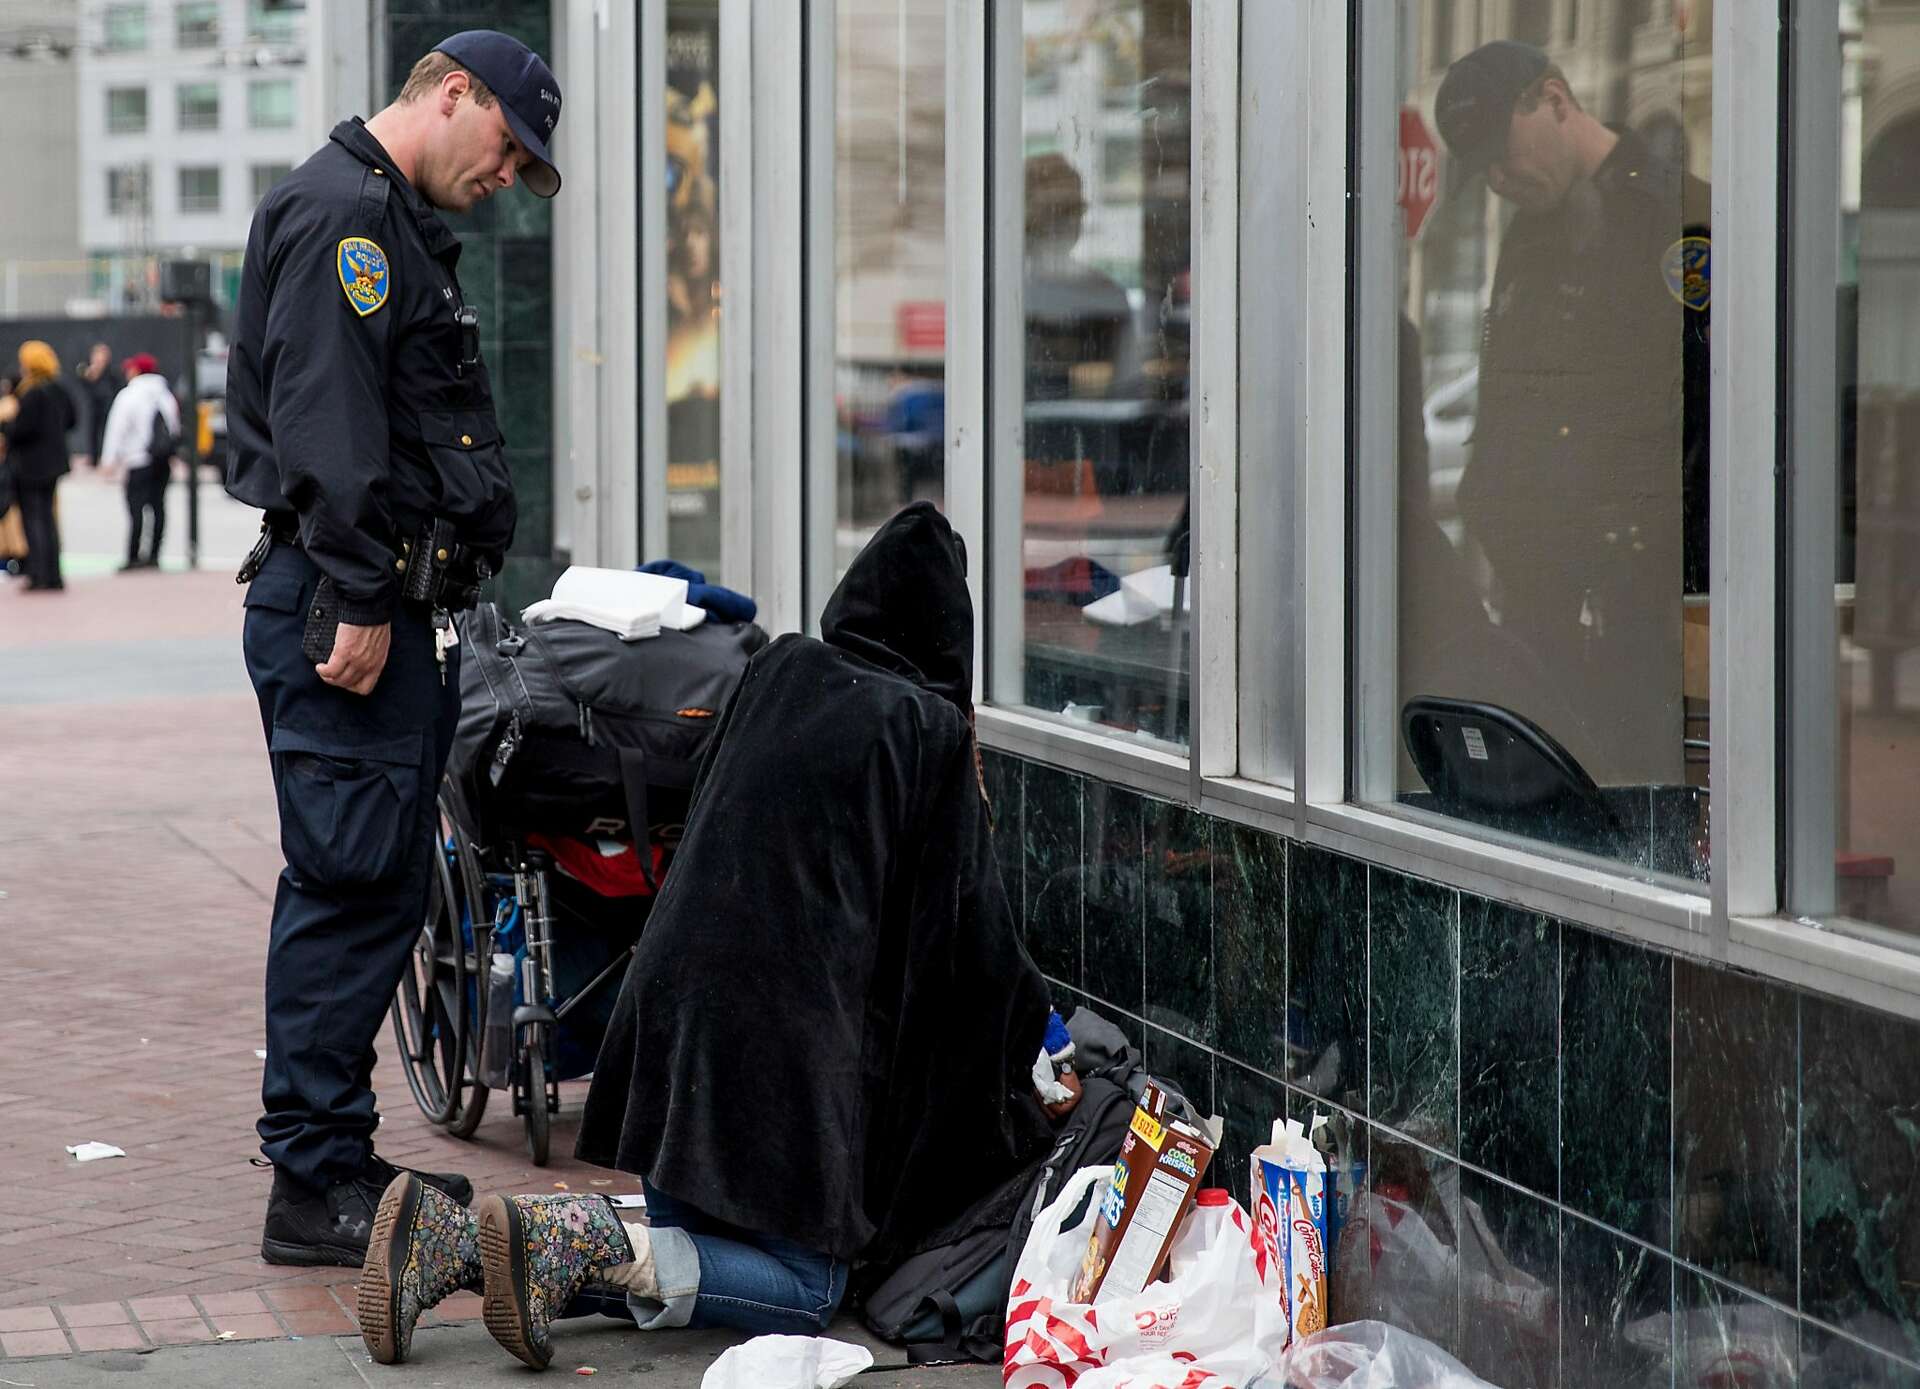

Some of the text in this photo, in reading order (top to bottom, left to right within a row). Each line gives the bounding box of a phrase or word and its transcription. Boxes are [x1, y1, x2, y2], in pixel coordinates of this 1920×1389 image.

[1138, 1118, 1154, 1137] SIZE
[1159, 1153, 1197, 1179] KRISPIES
[1168, 1148, 1195, 1168] COCOA
[1293, 1219, 1321, 1282] Coffee Cakes
